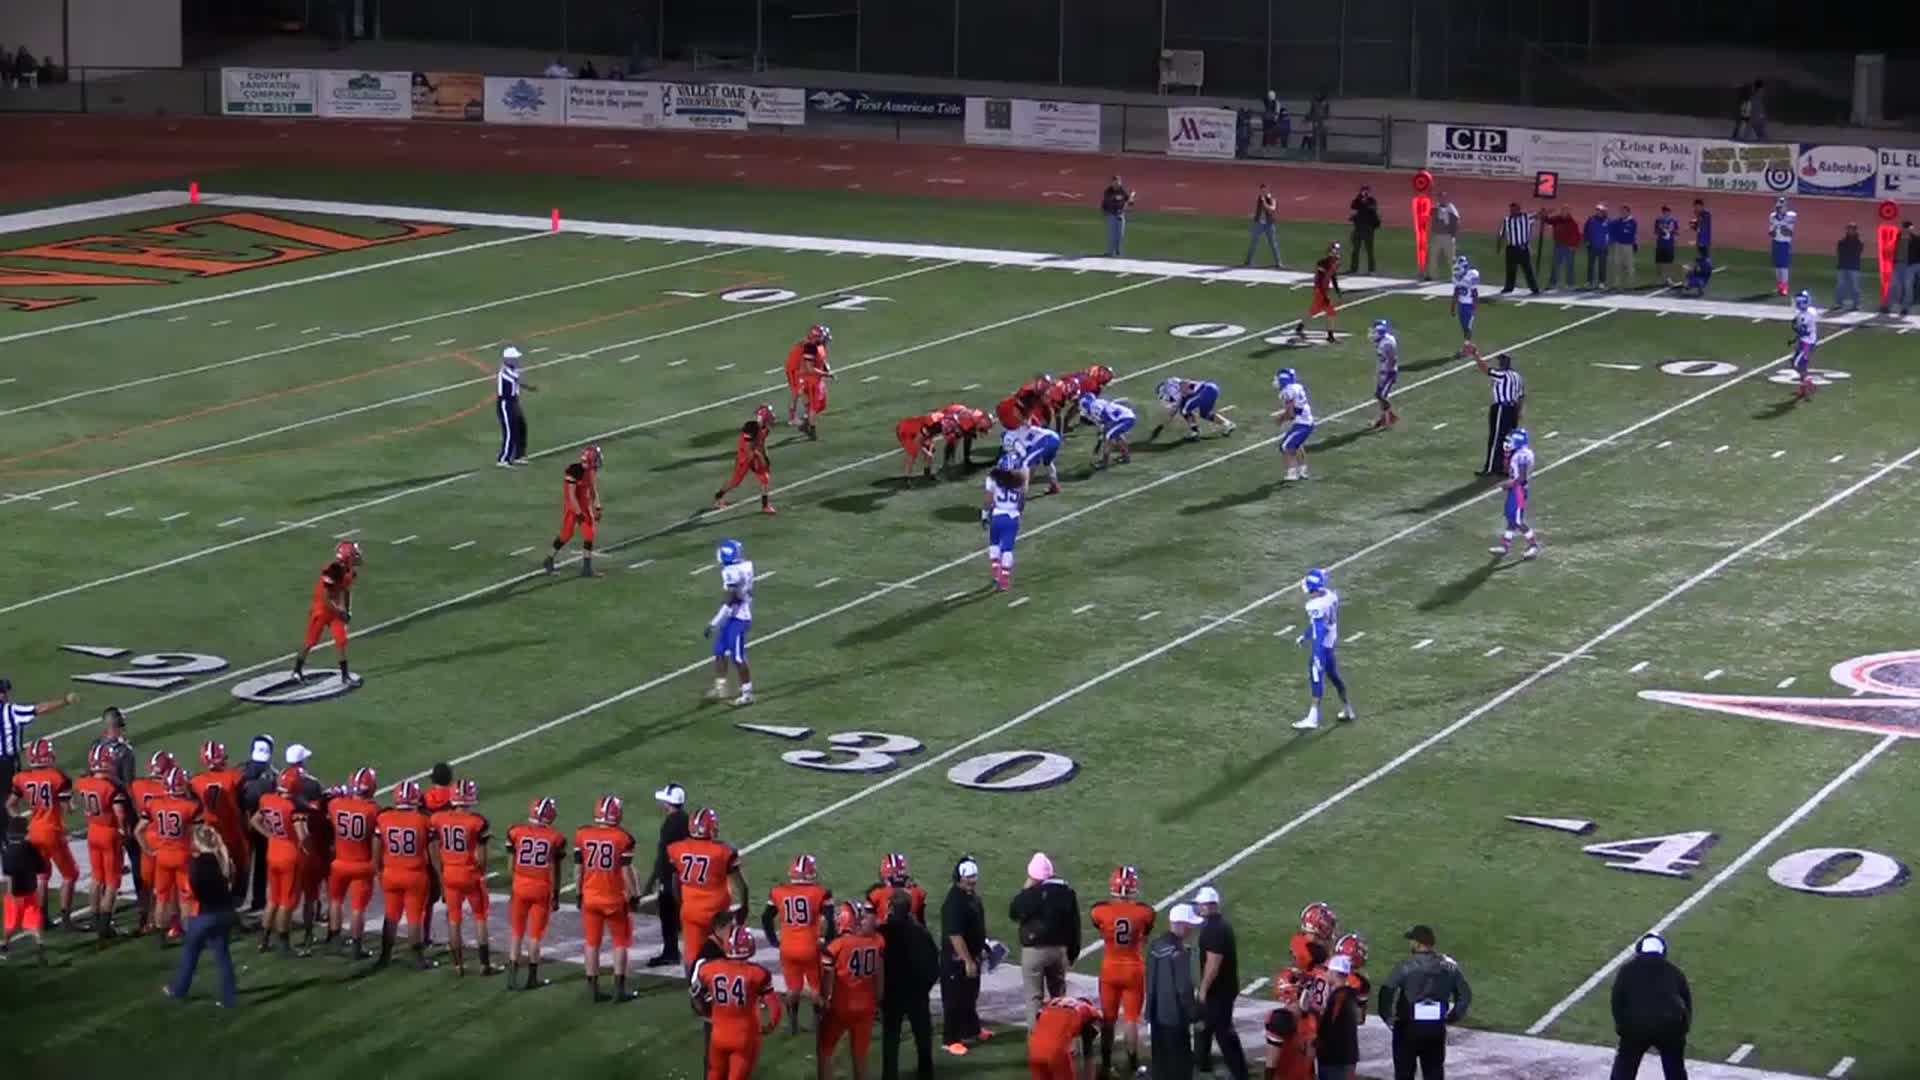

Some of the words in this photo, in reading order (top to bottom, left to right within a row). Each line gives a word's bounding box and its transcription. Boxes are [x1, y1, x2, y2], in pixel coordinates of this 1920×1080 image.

[239, 81, 300, 89] SANITATION
[247, 71, 290, 80] COUNTY
[242, 90, 296, 98] COMPANY
[676, 85, 718, 97] VALLEY
[721, 87, 746, 99] OAK
[855, 93, 880, 111] First
[882, 101, 934, 112] American
[937, 103, 960, 115] Title
[1452, 129, 1500, 150] CIP
[1430, 151, 1473, 160] POWDER
[1478, 153, 1520, 163] COATING
[1818, 160, 1872, 175] Rabobank
[1539, 173, 1555, 192] 2
[26, 783, 51, 808] 74
[157, 811, 182, 837] 13
[336, 811, 366, 839] 50
[388, 827, 417, 855] 58
[442, 827, 467, 853] 16
[518, 838, 549, 866] 22
[584, 842, 614, 869] 78
[680, 854, 709, 883] 77
[783, 897, 810, 926] 19
[1114, 918, 1131, 945] 2
[848, 947, 878, 977] 40
[712, 975, 747, 1007] 64
